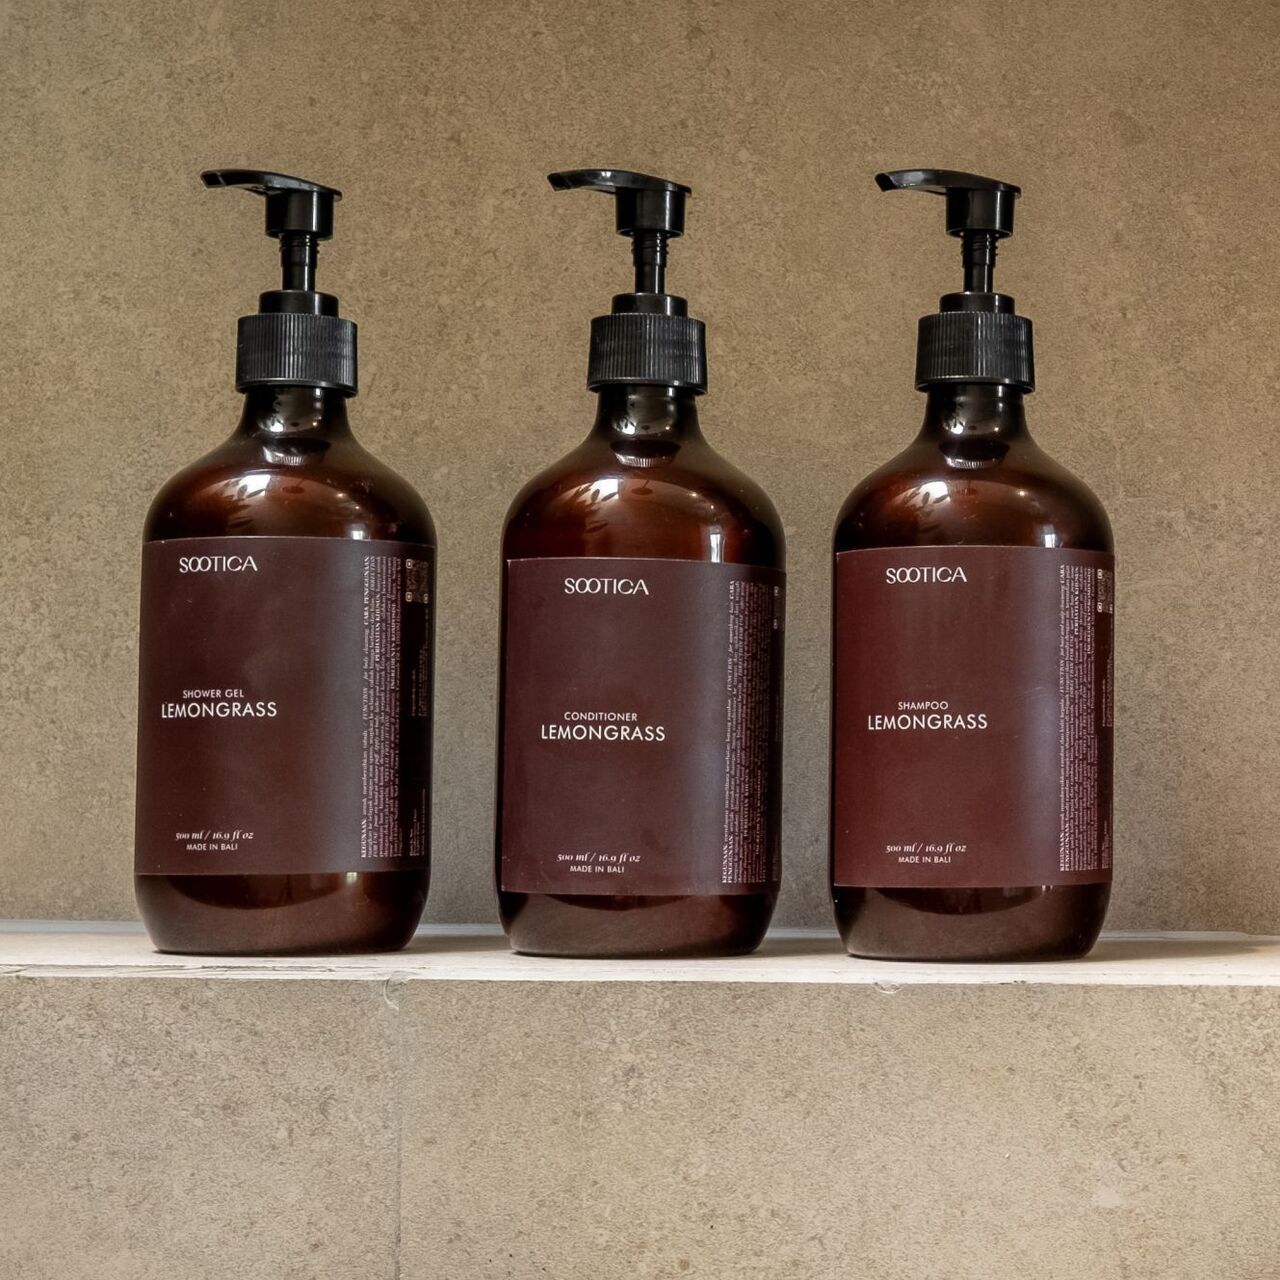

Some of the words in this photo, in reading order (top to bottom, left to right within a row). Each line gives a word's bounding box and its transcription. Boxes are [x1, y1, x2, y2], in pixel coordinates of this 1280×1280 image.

[179, 555, 258, 573] SOOTICA
[886, 566, 968, 584] SOOTICA
[564, 577, 649, 595] SOOTICA
[183, 689, 221, 699] SHOWER
[225, 688, 245, 698] GEL
[161, 701, 278, 719] LEMONGRASS
[898, 701, 949, 710] SHAMPOO
[564, 711, 638, 721] CONDITIONER
[868, 713, 988, 730] LEMONGRASS
[541, 724, 666, 741] LEMONGRASS
[175, 832, 190, 841] 500
[191, 830, 205, 840] ml
[212, 831, 230, 841] 16.9
[242, 832, 254, 840] oz
[186, 843, 207, 851] MADE
[885, 845, 901, 853] 500
[903, 842, 917, 852] ml
[925, 843, 943, 853] 16.9
[570, 865, 592, 873] MADE
[595, 865, 604, 873] IN
[607, 865, 625, 873] BALI
